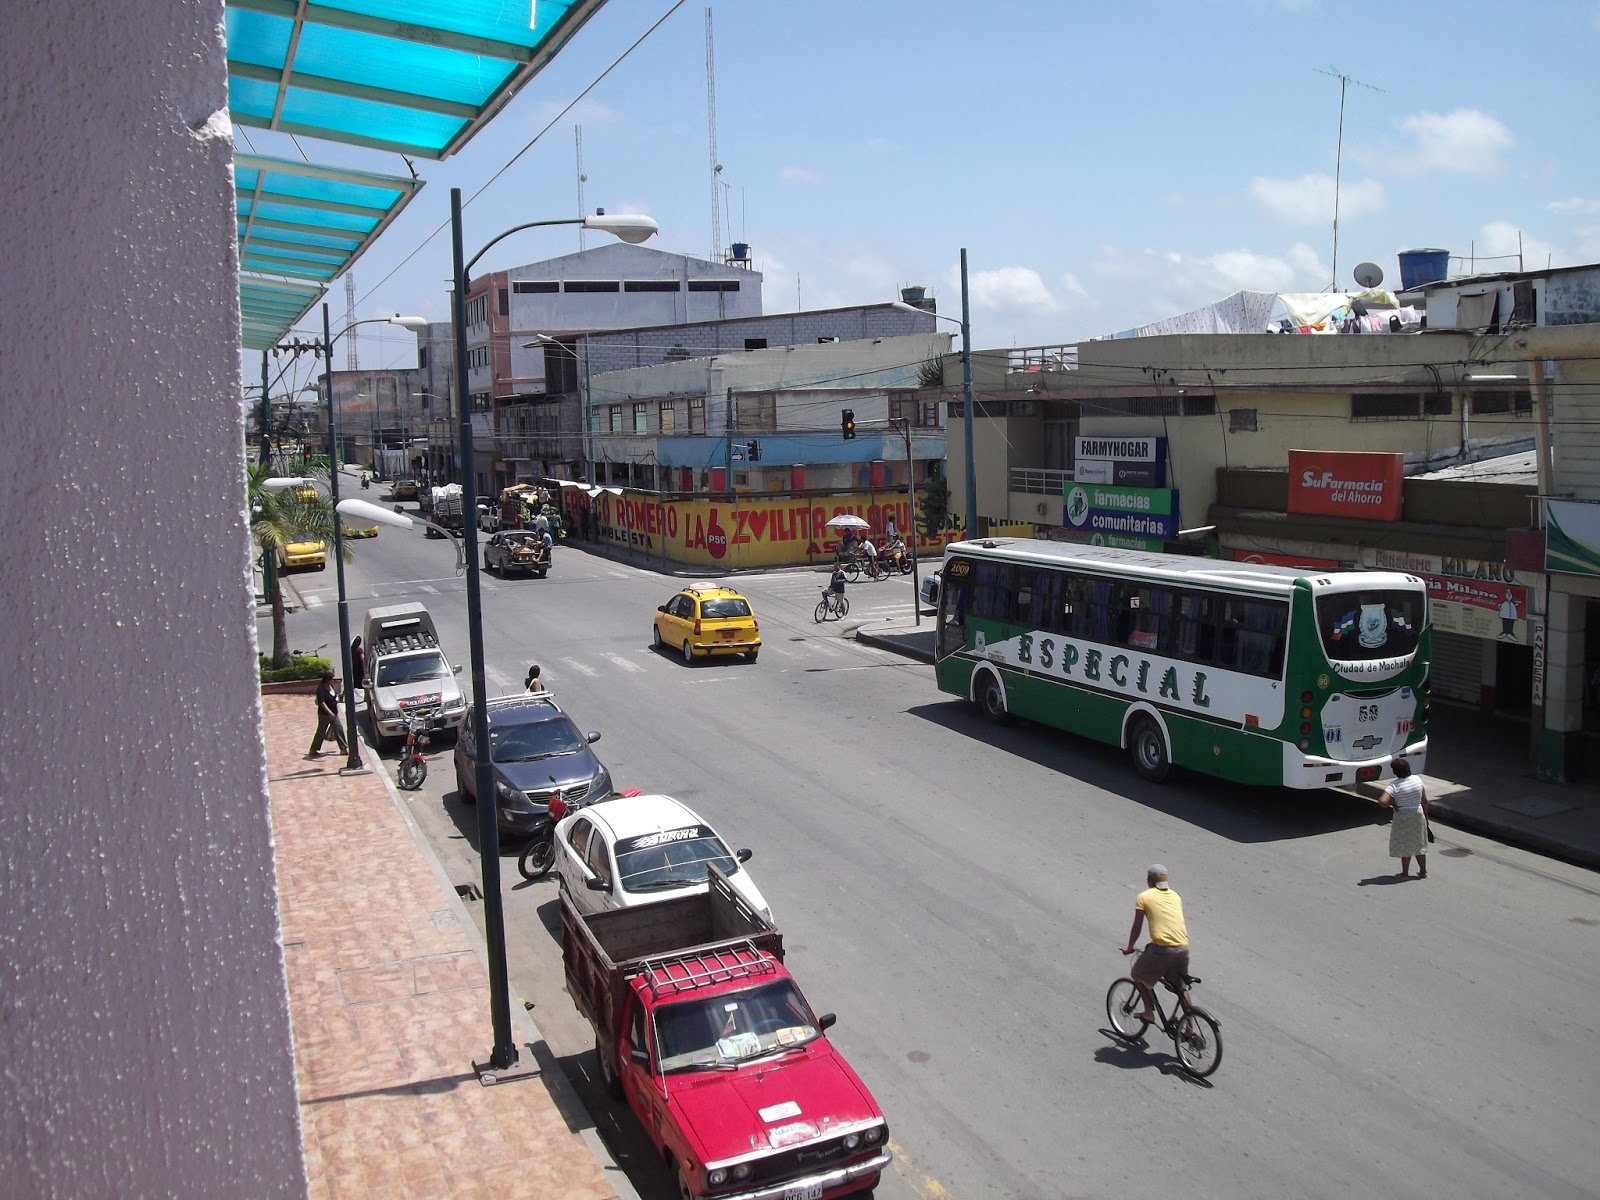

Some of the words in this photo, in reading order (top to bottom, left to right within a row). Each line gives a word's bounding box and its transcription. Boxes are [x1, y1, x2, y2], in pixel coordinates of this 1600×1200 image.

[1082, 441, 1148, 458] FARMYHOGAR
[1302, 471, 1383, 491] SuFarmacia
[1094, 488, 1150, 510] farmacias
[1331, 490, 1346, 502] del
[1348, 491, 1382, 504] Ahorro
[615, 498, 677, 538] ROMERO
[1092, 515, 1164, 535] comunitarias
[684, 512, 707, 550] LA
[708, 535, 726, 545] PSC
[1108, 534, 1147, 550] farmacias
[951, 563, 970, 574] 2009
[1441, 557, 1516, 583] MILANO
[1446, 581, 1498, 599] Milano
[1018, 634, 1211, 708] ESPECIAL
[1333, 661, 1364, 674] Ciudad
[1367, 661, 1378, 673] de
[1379, 658, 1410, 672] Machala
